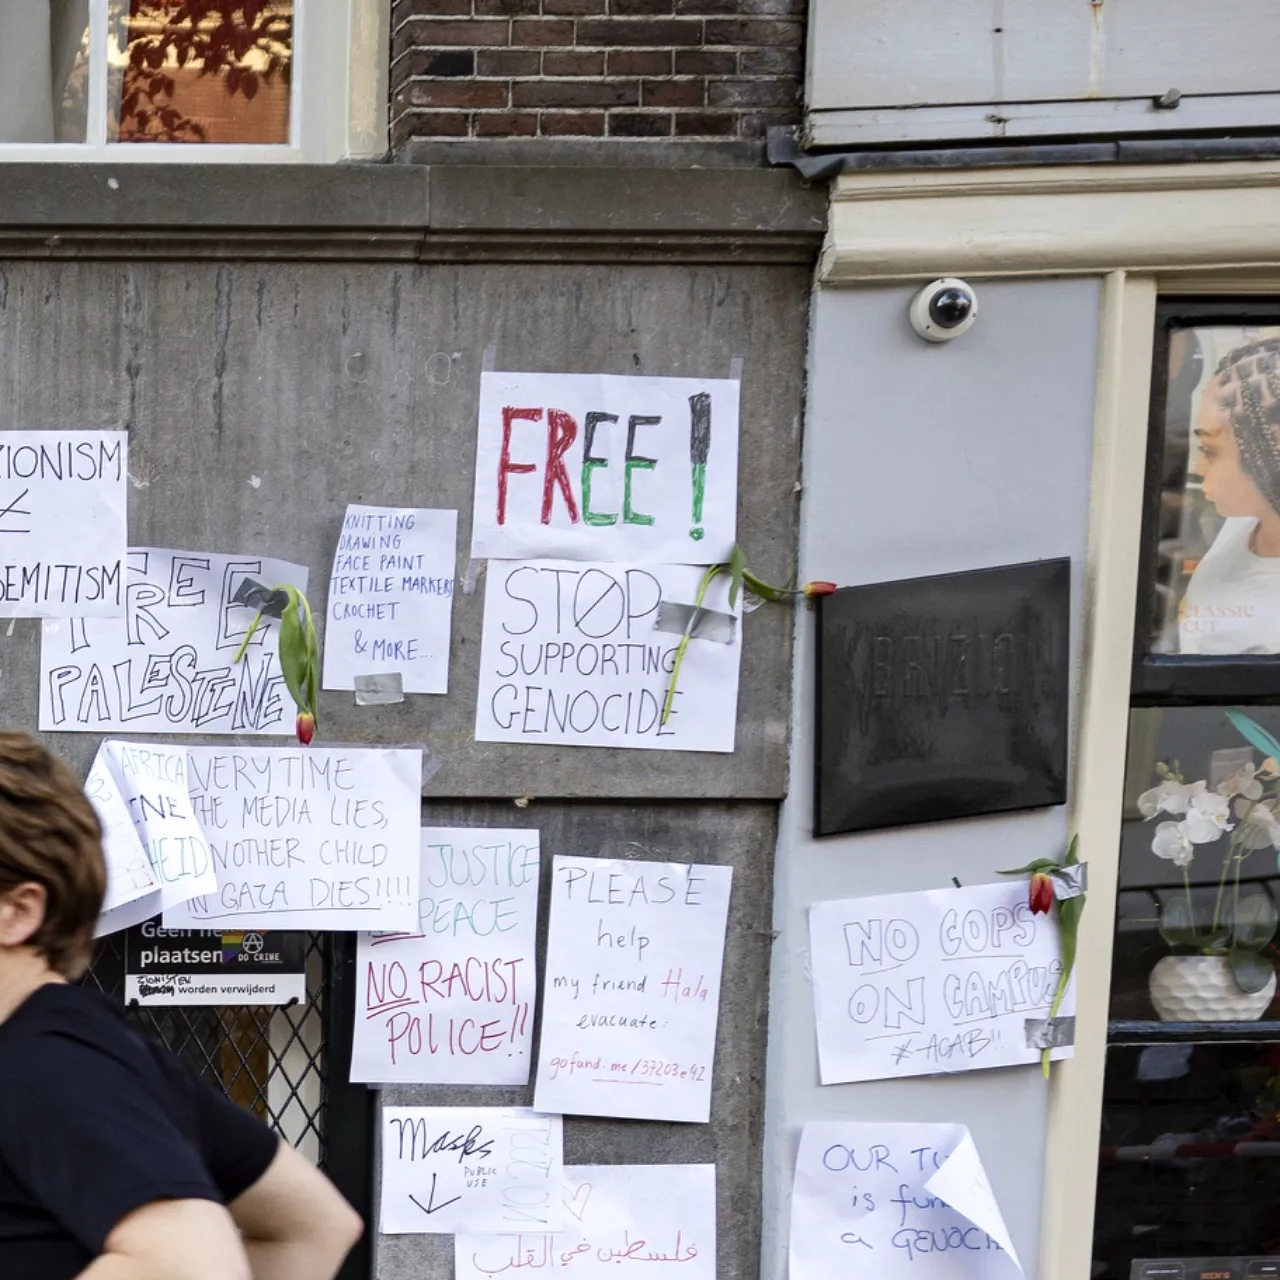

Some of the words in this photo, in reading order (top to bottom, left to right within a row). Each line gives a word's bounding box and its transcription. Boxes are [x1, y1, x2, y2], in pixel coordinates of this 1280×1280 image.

[345, 514, 415, 530] KNITTING
[339, 535, 401, 550] DRAWING
[336, 554, 370, 571] FACE
[379, 555, 425, 570] PAINT
[332, 576, 392, 594] TEXTILE
[402, 578, 455, 598] MARKERS
[333, 602, 400, 620] CROCHET
[502, 567, 661, 639] STOP
[354, 630, 367, 652] &
[496, 641, 679, 678] SUPPORTING
[49, 645, 285, 731] PALESTINE
[491, 684, 683, 736] GENOCIDE
[278, 756, 354, 791] TIME
[242, 798, 312, 826] MEDIA
[331, 800, 388, 827] LIES,
[319, 841, 388, 867] CHILD
[427, 842, 539, 887] JUSTICE
[222, 880, 288, 911] GAZA
[558, 864, 706, 907] PLEASE
[418, 898, 519, 937] PEACE
[598, 919, 651, 961] help
[843, 919, 919, 966] NO
[940, 901, 1036, 956] COPS
[141, 946, 223, 967] plaatsen
[178, 985, 217, 993] worden
[220, 984, 275, 995] verwijderd
[366, 961, 409, 1008] NO
[419, 957, 524, 1006] RACIST
[554, 975, 579, 999] my
[593, 971, 645, 995] friend
[848, 977, 925, 1030] ON
[823, 1145, 898, 1173] OUR
[852, 1186, 875, 1208] is
